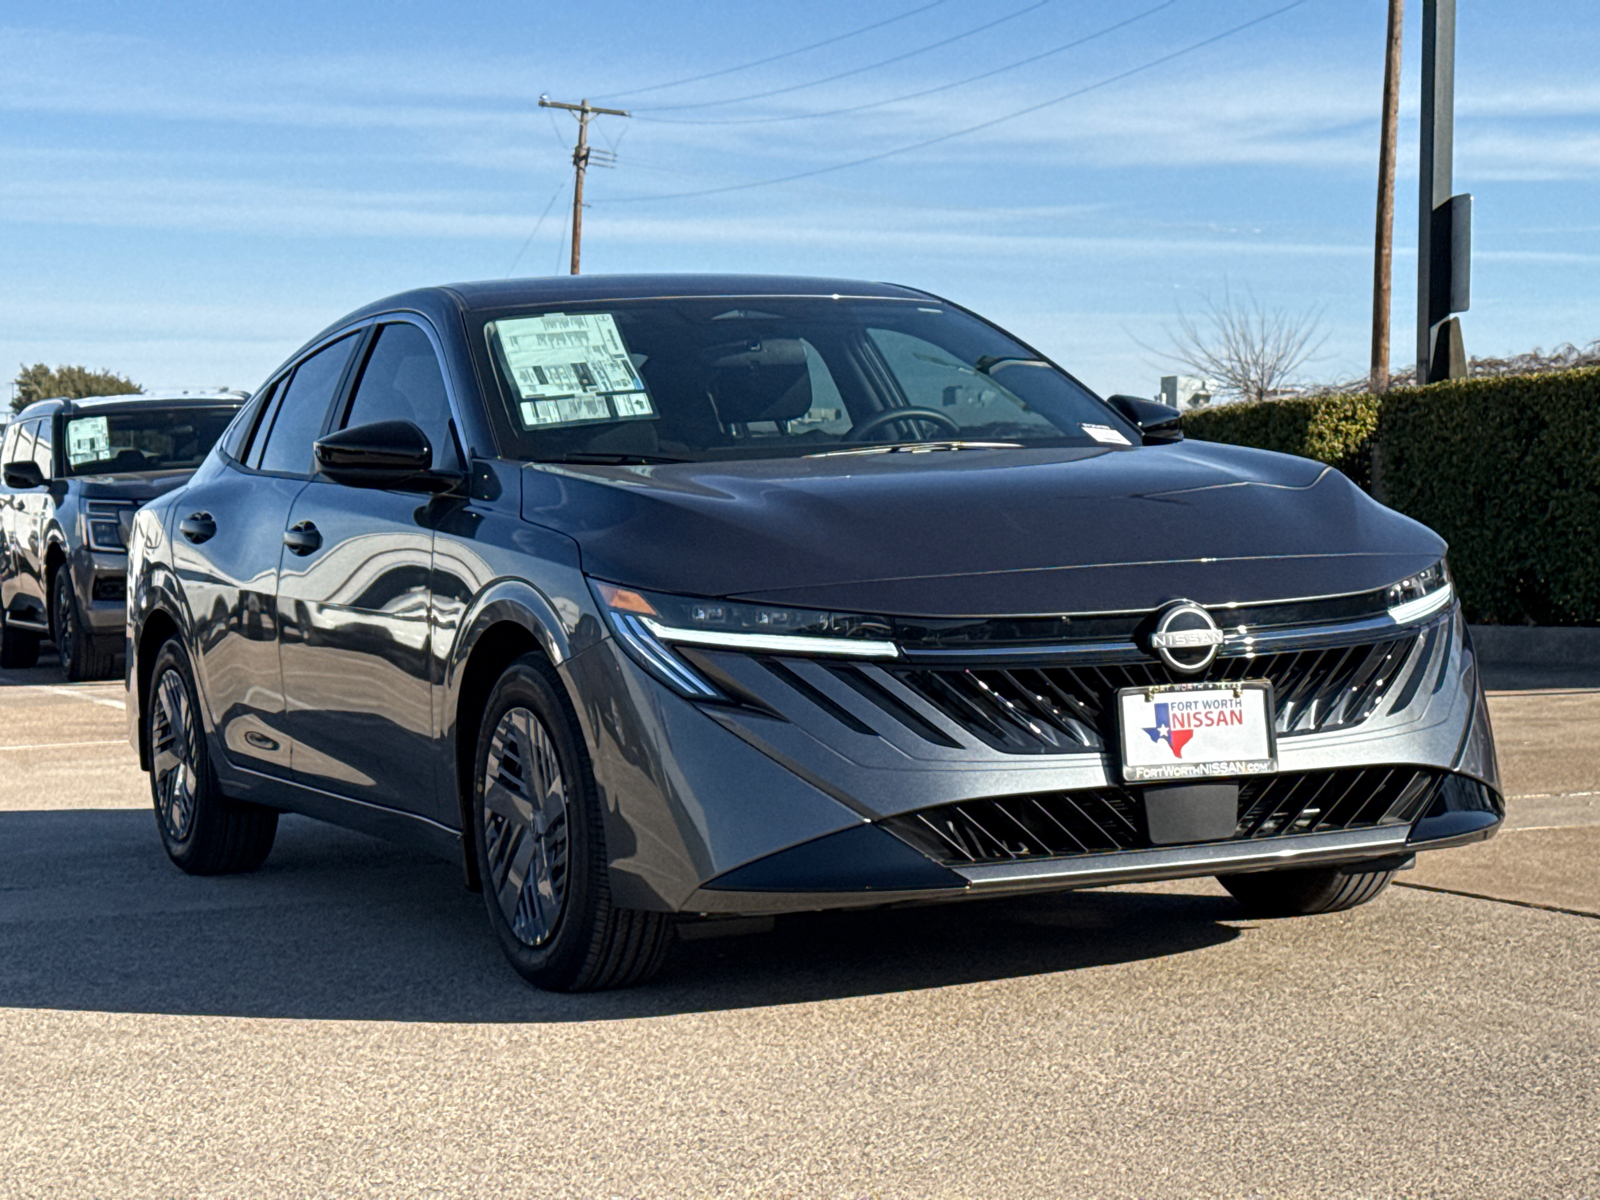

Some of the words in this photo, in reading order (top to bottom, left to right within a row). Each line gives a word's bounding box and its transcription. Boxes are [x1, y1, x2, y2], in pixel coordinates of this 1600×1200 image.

[1153, 632, 1223, 647] NISSAN
[1148, 685, 1170, 693] FORT
[1174, 683, 1204, 691] WORTH
[1217, 682, 1242, 690] TEXAS
[1170, 700, 1199, 712] FORT
[1201, 698, 1242, 710] WORTH
[1171, 709, 1243, 729] NISSAN
